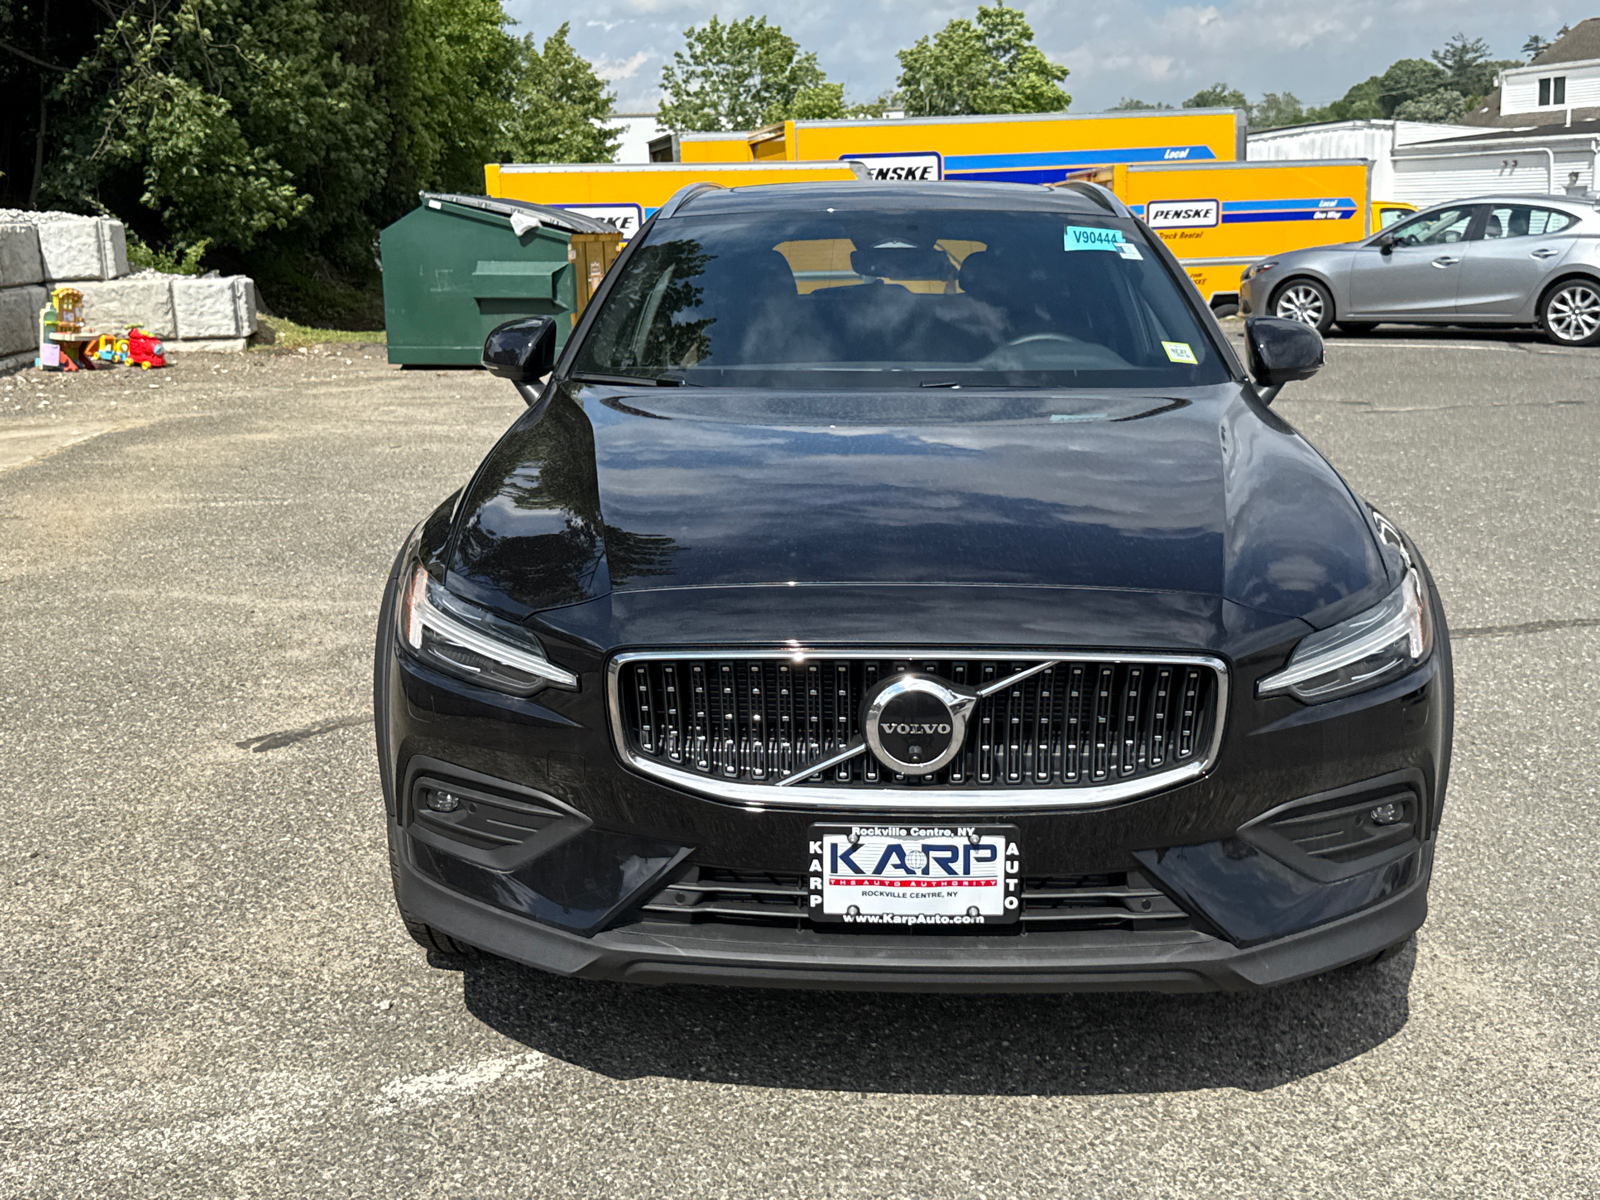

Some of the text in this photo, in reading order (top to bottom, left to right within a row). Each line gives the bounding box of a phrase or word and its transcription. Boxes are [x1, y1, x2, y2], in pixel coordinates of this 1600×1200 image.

[1164, 148, 1190, 159] Local
[1153, 208, 1213, 220] PENSKE
[1073, 230, 1118, 244] V90444
[880, 723, 951, 734] VOLVO
[851, 827, 907, 837] Rockville
[957, 827, 975, 836] NY
[830, 843, 997, 875] KARP
[809, 841, 823, 907] KARP
[1004, 842, 1019, 909] AUTO
[861, 890, 907, 899] ROCKVILLE
[843, 913, 985, 926] www.KarpAuto.com
